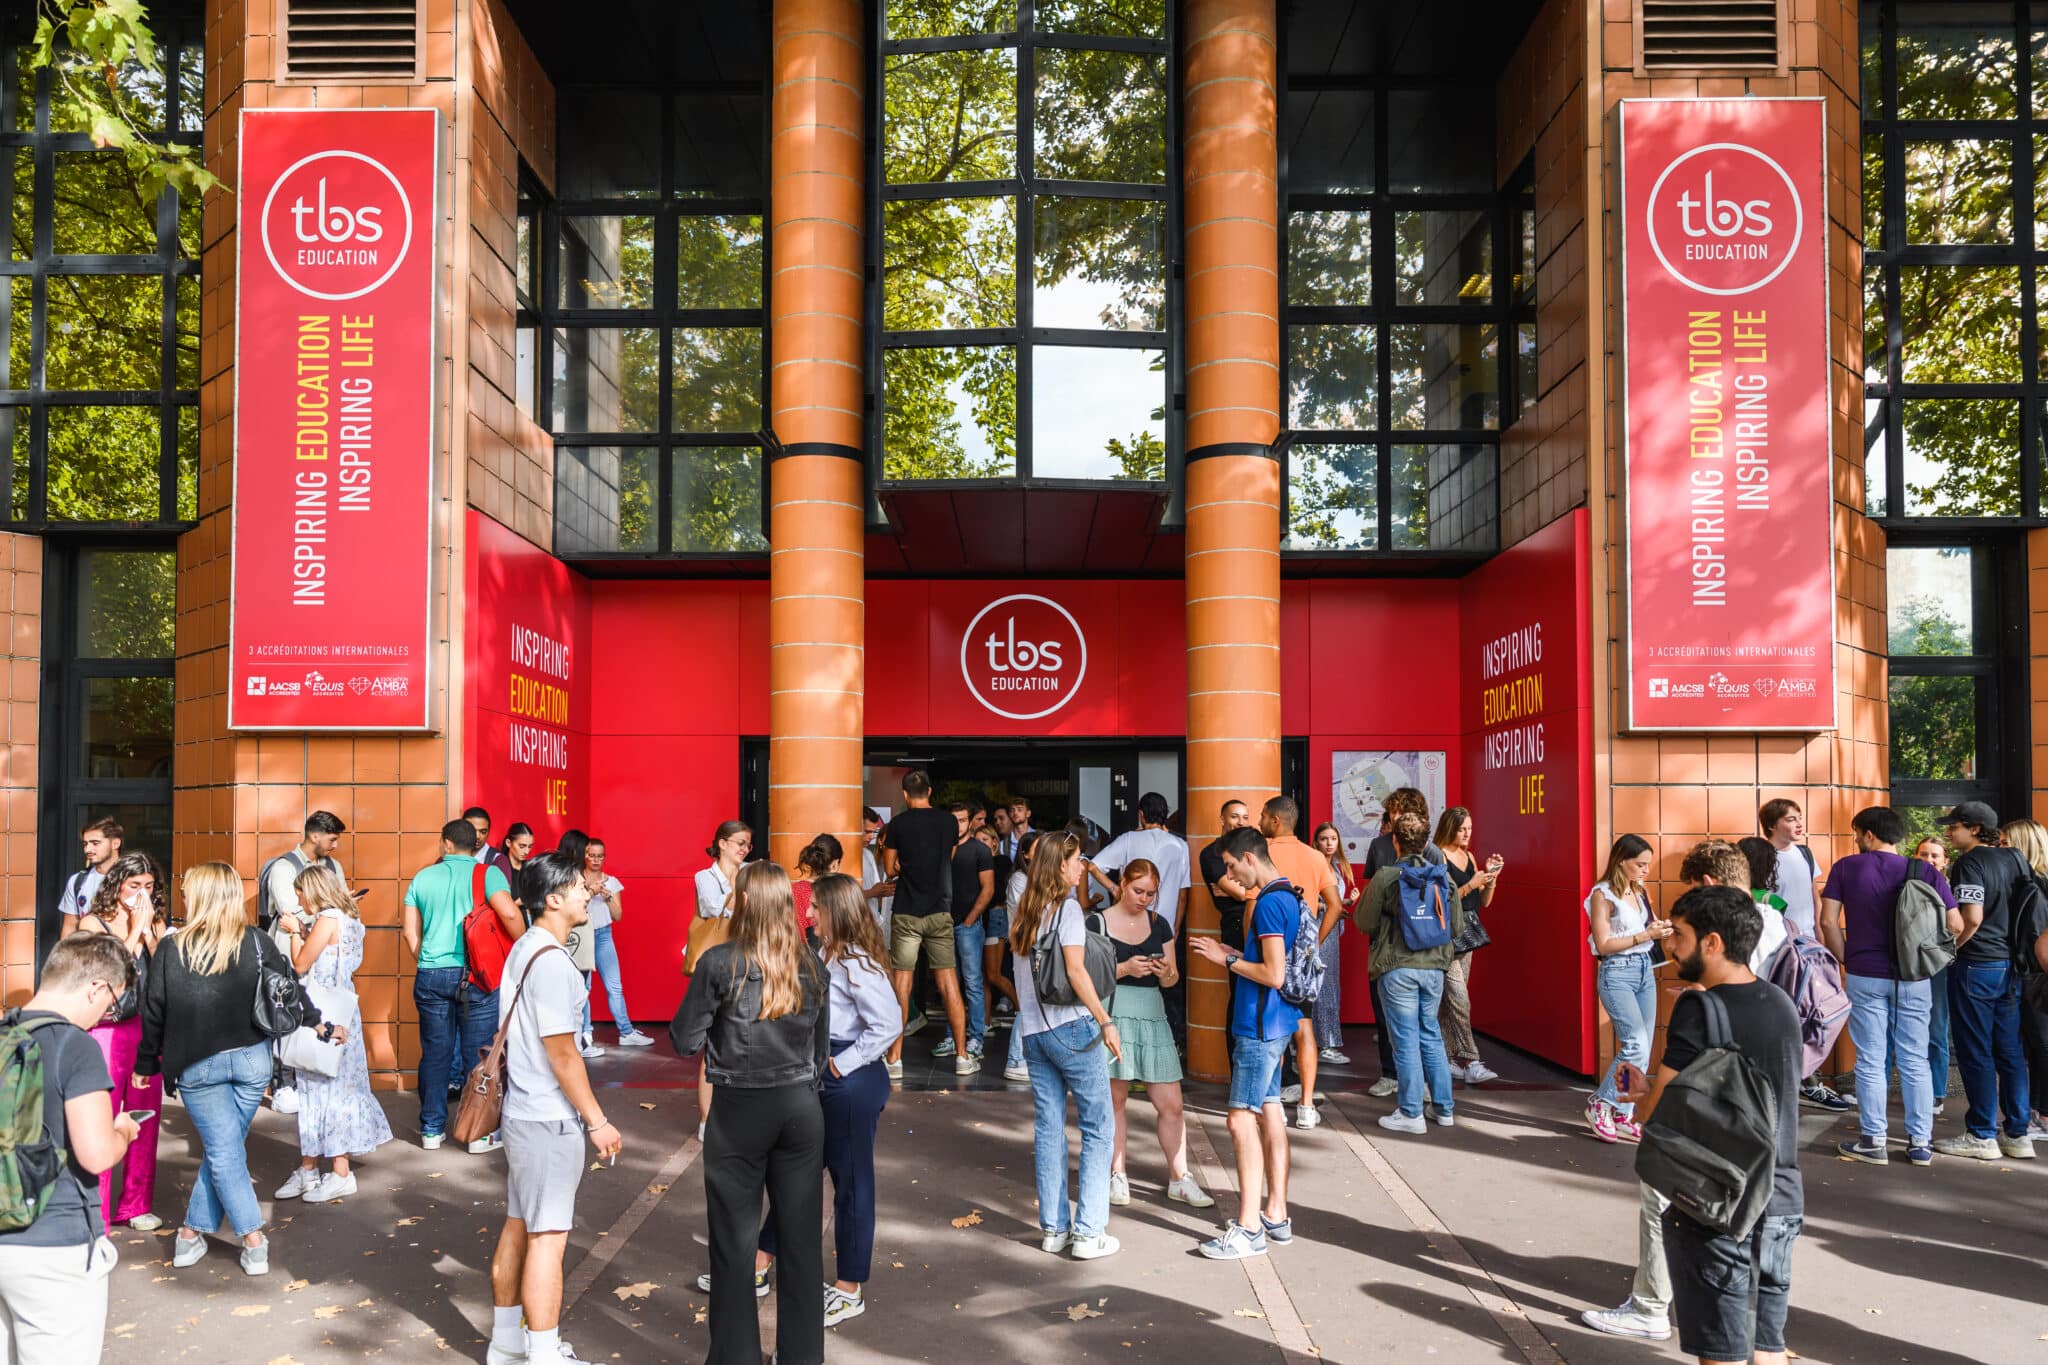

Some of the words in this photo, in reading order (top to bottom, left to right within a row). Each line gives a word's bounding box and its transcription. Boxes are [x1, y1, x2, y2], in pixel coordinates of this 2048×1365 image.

[291, 176, 383, 244] tbs
[1677, 169, 1772, 237] tbs
[297, 249, 378, 266] EDUCATION
[1685, 243, 1768, 260] EDUCATION
[341, 314, 374, 368] LIFE
[1733, 309, 1767, 364] LIFE
[296, 315, 330, 460] EDUCATION
[1689, 311, 1721, 460] EDUCATION
[339, 378, 373, 512] INSPIRING
[1735, 375, 1769, 511] INSPIRING
[293, 471, 327, 606] INSPIRING
[1693, 471, 1726, 606] INSPIRING
[248, 645, 254, 656] 3
[257, 644, 329, 656] ACCRÉDITATIONS
[331, 645, 409, 656] INTERNATIONALES
[511, 623, 569, 681] INSPIRING
[985, 615, 1063, 672] tbs
[1483, 622, 1542, 681] INSPIRING
[1648, 646, 1654, 657] 3
[1657, 645, 1732, 657] ACCRÉDITATIONS
[1735, 646, 1816, 657] INTERNATIONALES
[269, 682, 301, 691] AACSB
[312, 682, 345, 691] EQUIS
[510, 673, 568, 726] EDUCATION
[991, 677, 1058, 691] EDUCATION
[1483, 672, 1543, 726] EDUCATION
[1671, 683, 1704, 692] AACSB
[1716, 683, 1750, 693] EQUIS
[509, 722, 567, 770] INSPIRING
[1484, 722, 1544, 770] INSPIRING
[546, 778, 567, 815] LIFE
[1519, 774, 1545, 815] LIFE
